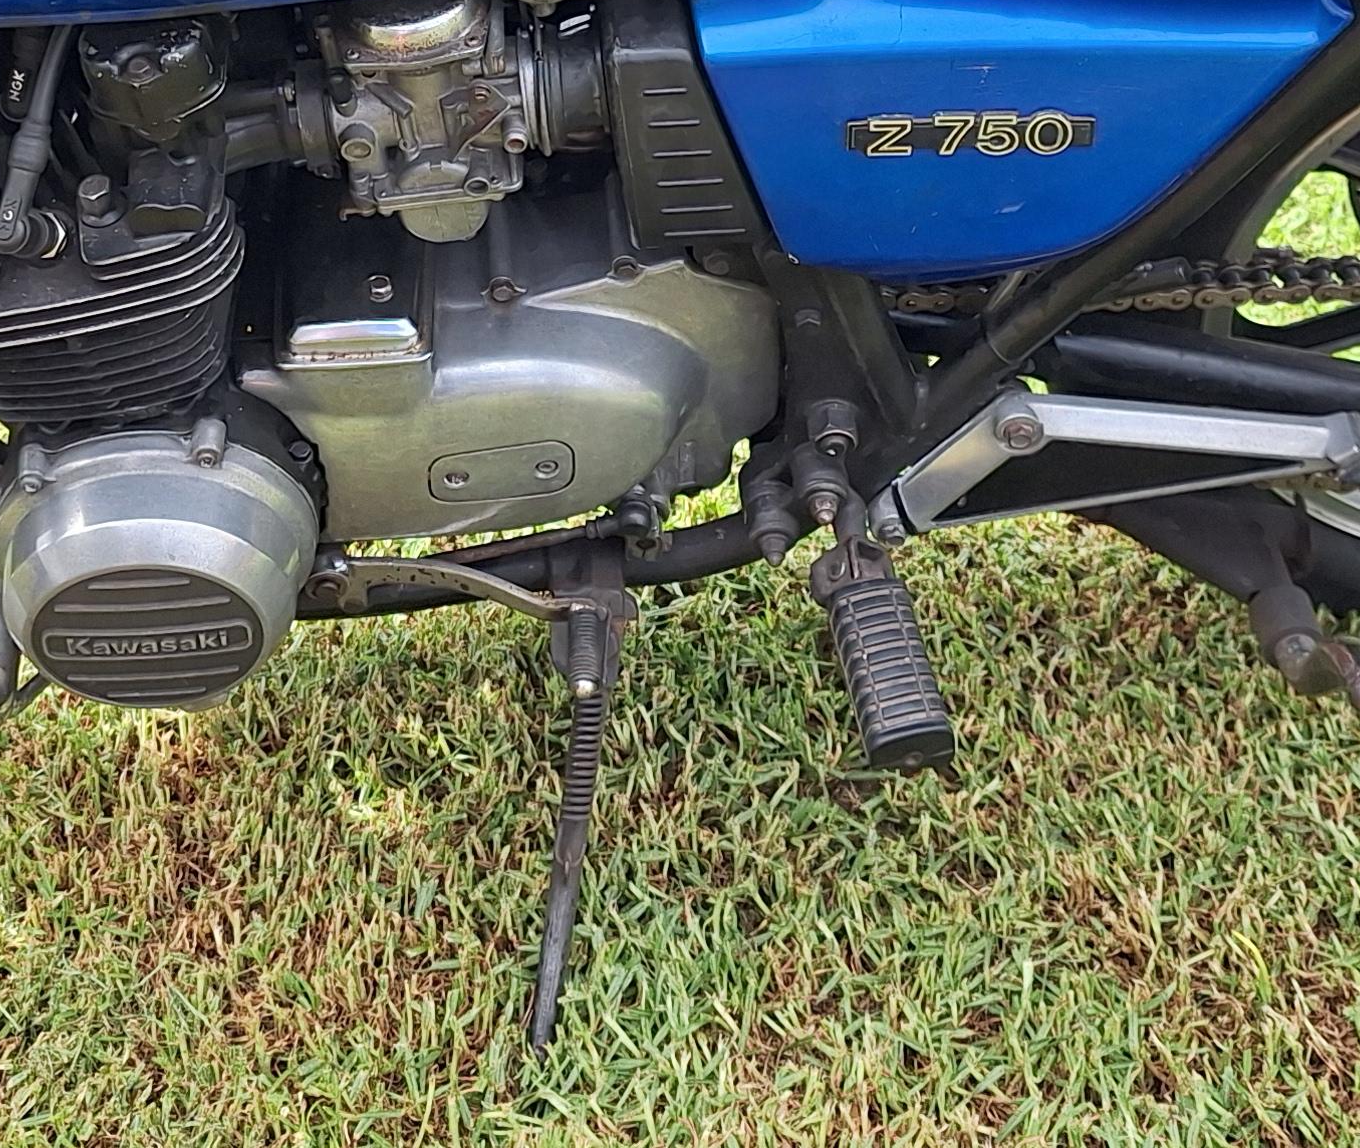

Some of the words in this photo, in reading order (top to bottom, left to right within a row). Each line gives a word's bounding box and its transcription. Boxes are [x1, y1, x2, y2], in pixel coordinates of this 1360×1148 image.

[9, 69, 25, 102] NGK
[866, 116, 914, 157] Z
[933, 112, 1075, 157] 750
[65, 629, 229, 656] Kawasaki
